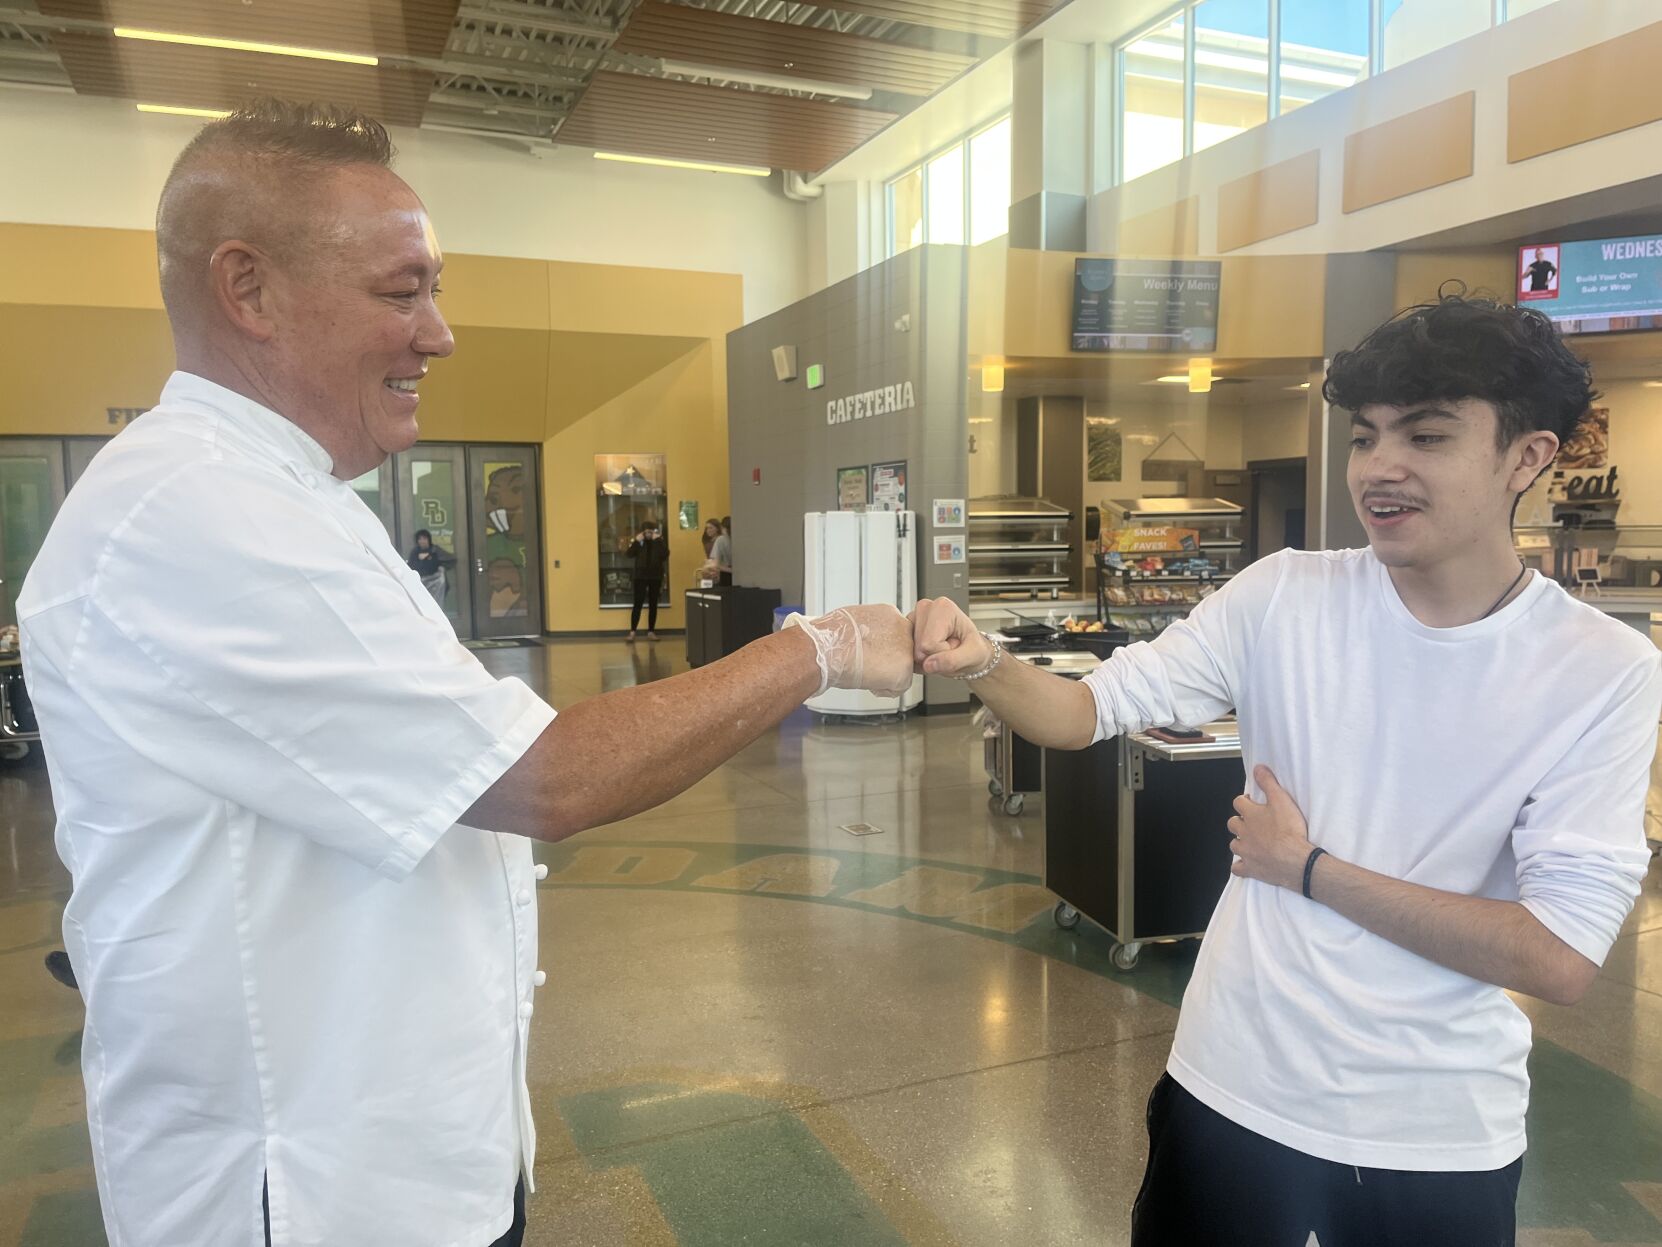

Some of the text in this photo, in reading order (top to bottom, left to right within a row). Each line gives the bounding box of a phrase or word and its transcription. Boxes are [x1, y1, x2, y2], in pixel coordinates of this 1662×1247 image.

[1601, 240, 1662, 260] WEDNES
[1576, 275, 1597, 283] Build
[1619, 272, 1638, 280] Own
[1143, 279, 1217, 292] Weekly Menu
[1582, 285, 1598, 293] Sub
[1610, 284, 1631, 292] Wrap
[827, 381, 915, 425] CAFETERIA
[1567, 466, 1619, 500] eat
[1134, 528, 1167, 537] SNACK
[1134, 542, 1167, 551] FAVES!
[540, 846, 1055, 935] DAM
